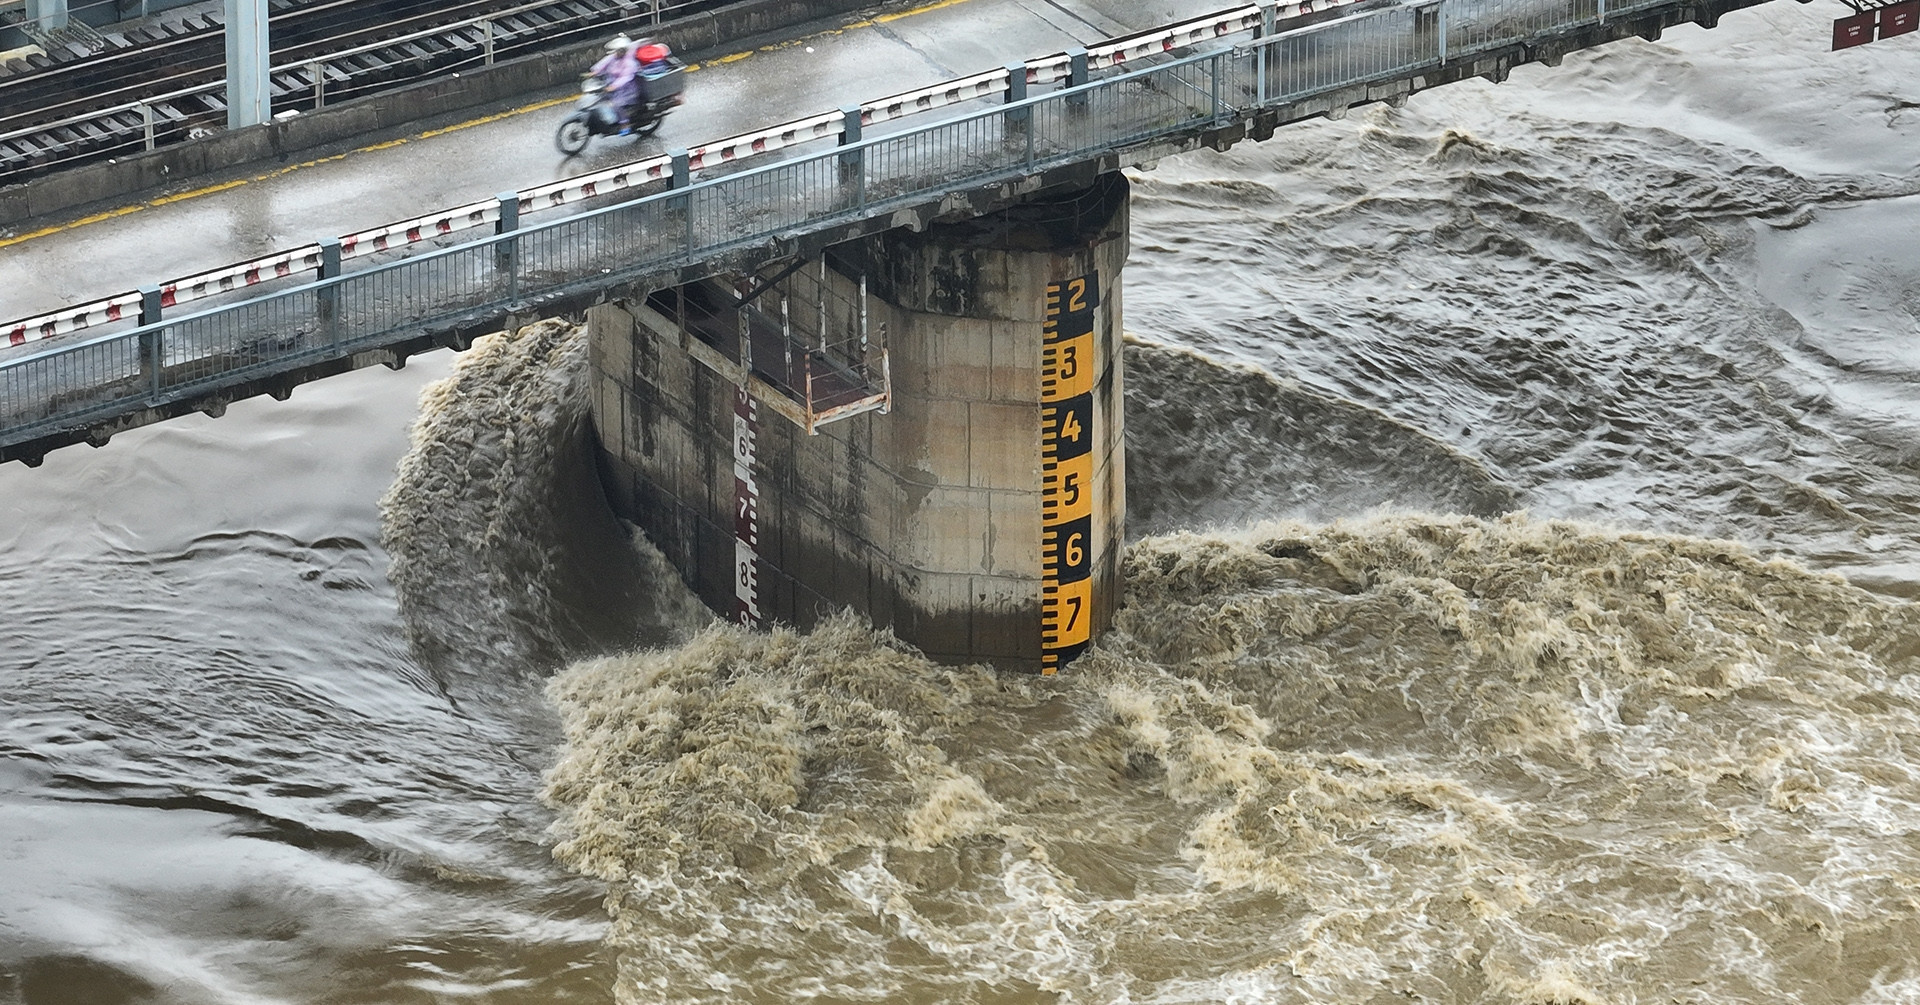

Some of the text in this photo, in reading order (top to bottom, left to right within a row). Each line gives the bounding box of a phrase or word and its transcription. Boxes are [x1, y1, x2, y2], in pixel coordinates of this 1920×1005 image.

[1067, 278, 1086, 312] 2
[1061, 346, 1077, 380] 3
[1061, 410, 1081, 442] 4
[739, 436, 747, 457] 6
[1064, 472, 1079, 506] 5
[739, 496, 748, 519] 7
[1065, 532, 1082, 567] 6
[740, 561, 749, 588] 8
[1066, 596, 1082, 632] 7
